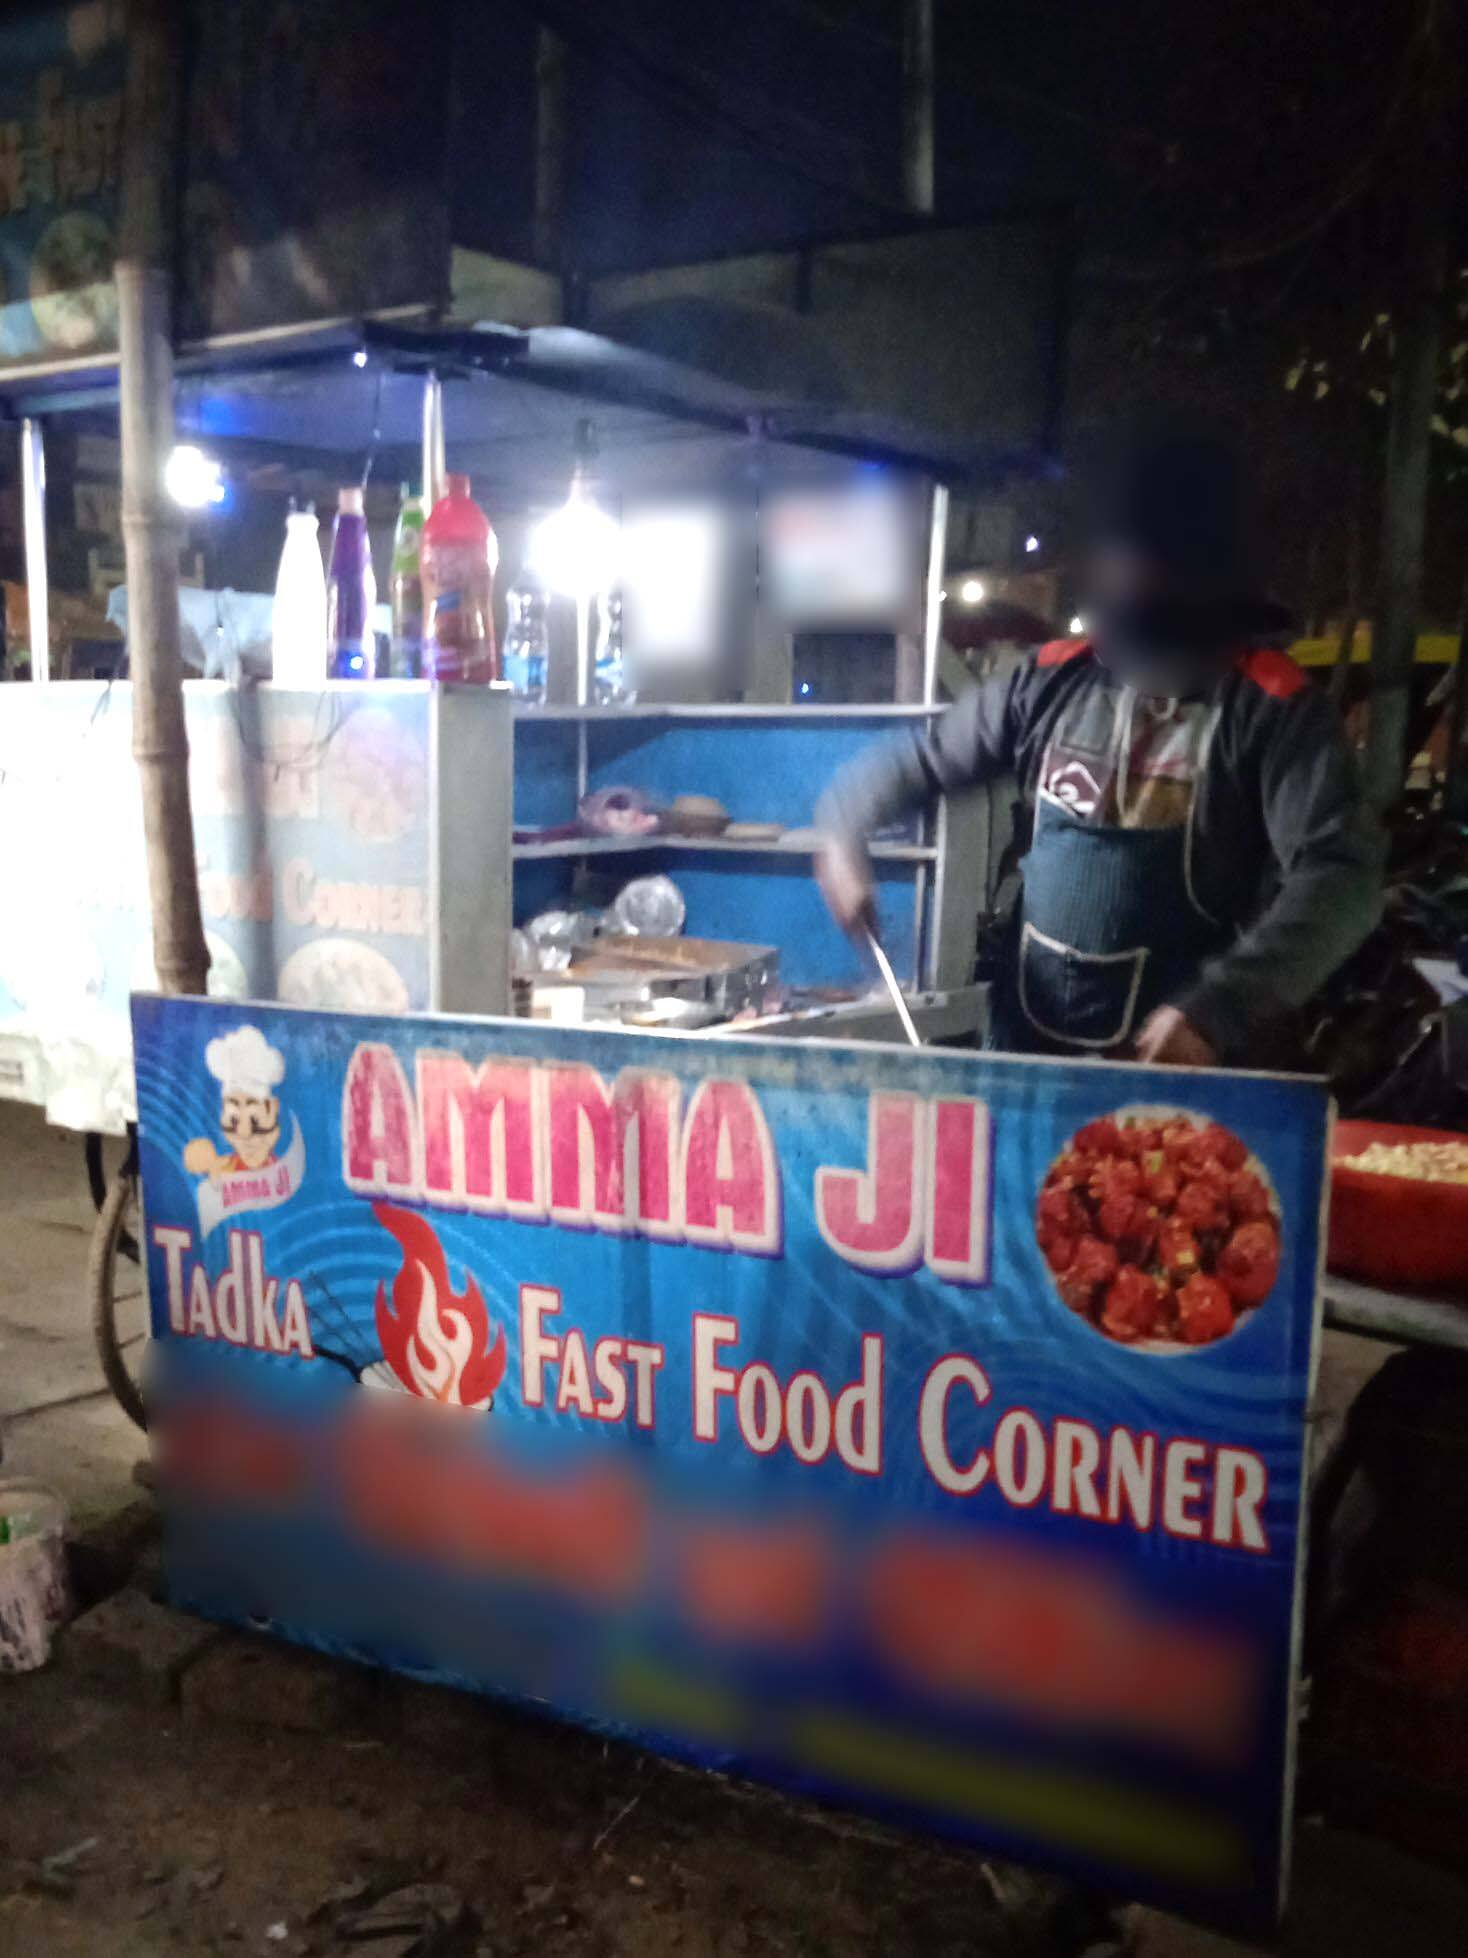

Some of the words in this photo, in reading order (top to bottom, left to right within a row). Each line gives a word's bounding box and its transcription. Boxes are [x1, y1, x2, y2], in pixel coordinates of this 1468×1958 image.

[341, 1042, 782, 1255] AMMA
[813, 1090, 992, 1284] JI
[518, 1286, 664, 1428] FAST
[918, 1354, 1270, 1553] CORNER
